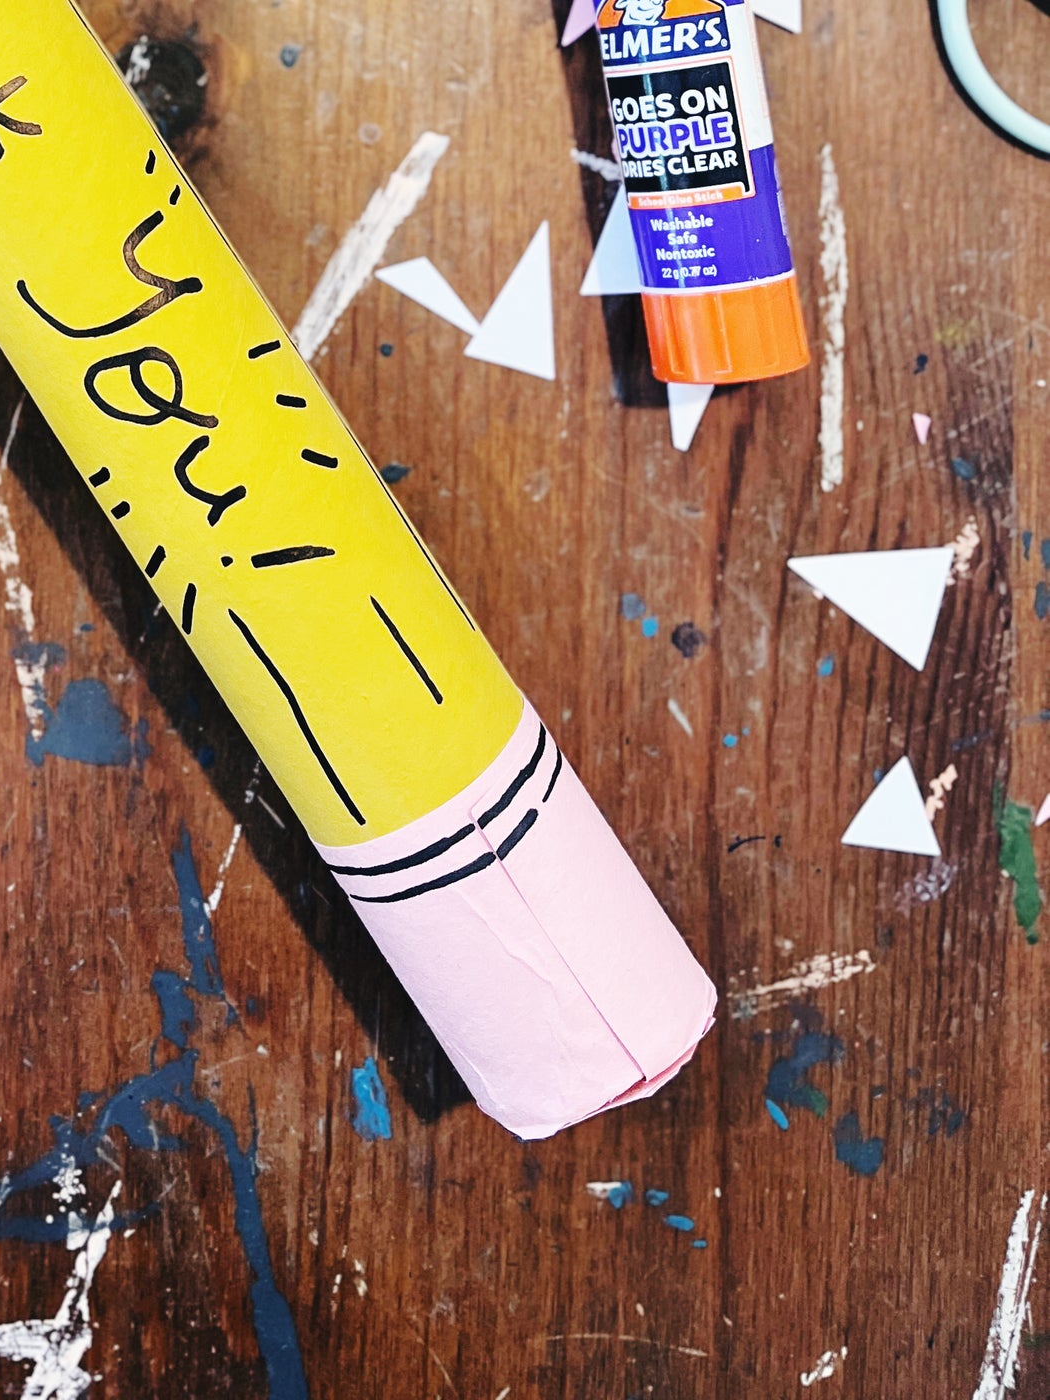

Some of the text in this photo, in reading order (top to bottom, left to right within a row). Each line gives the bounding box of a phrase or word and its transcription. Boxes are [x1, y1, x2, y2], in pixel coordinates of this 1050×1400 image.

[612, 85, 729, 122] GOES ON
[618, 114, 733, 155] PURPLE
[622, 149, 739, 178] DRIES CLEAR
[638, 190, 723, 207] School Glue Stick
[650, 214, 714, 232] Washable
[667, 232, 698, 246] Safe
[656, 244, 716, 261] Nontoxic
[661, 267, 672, 279] 22
[703, 264, 717, 278] oz)
